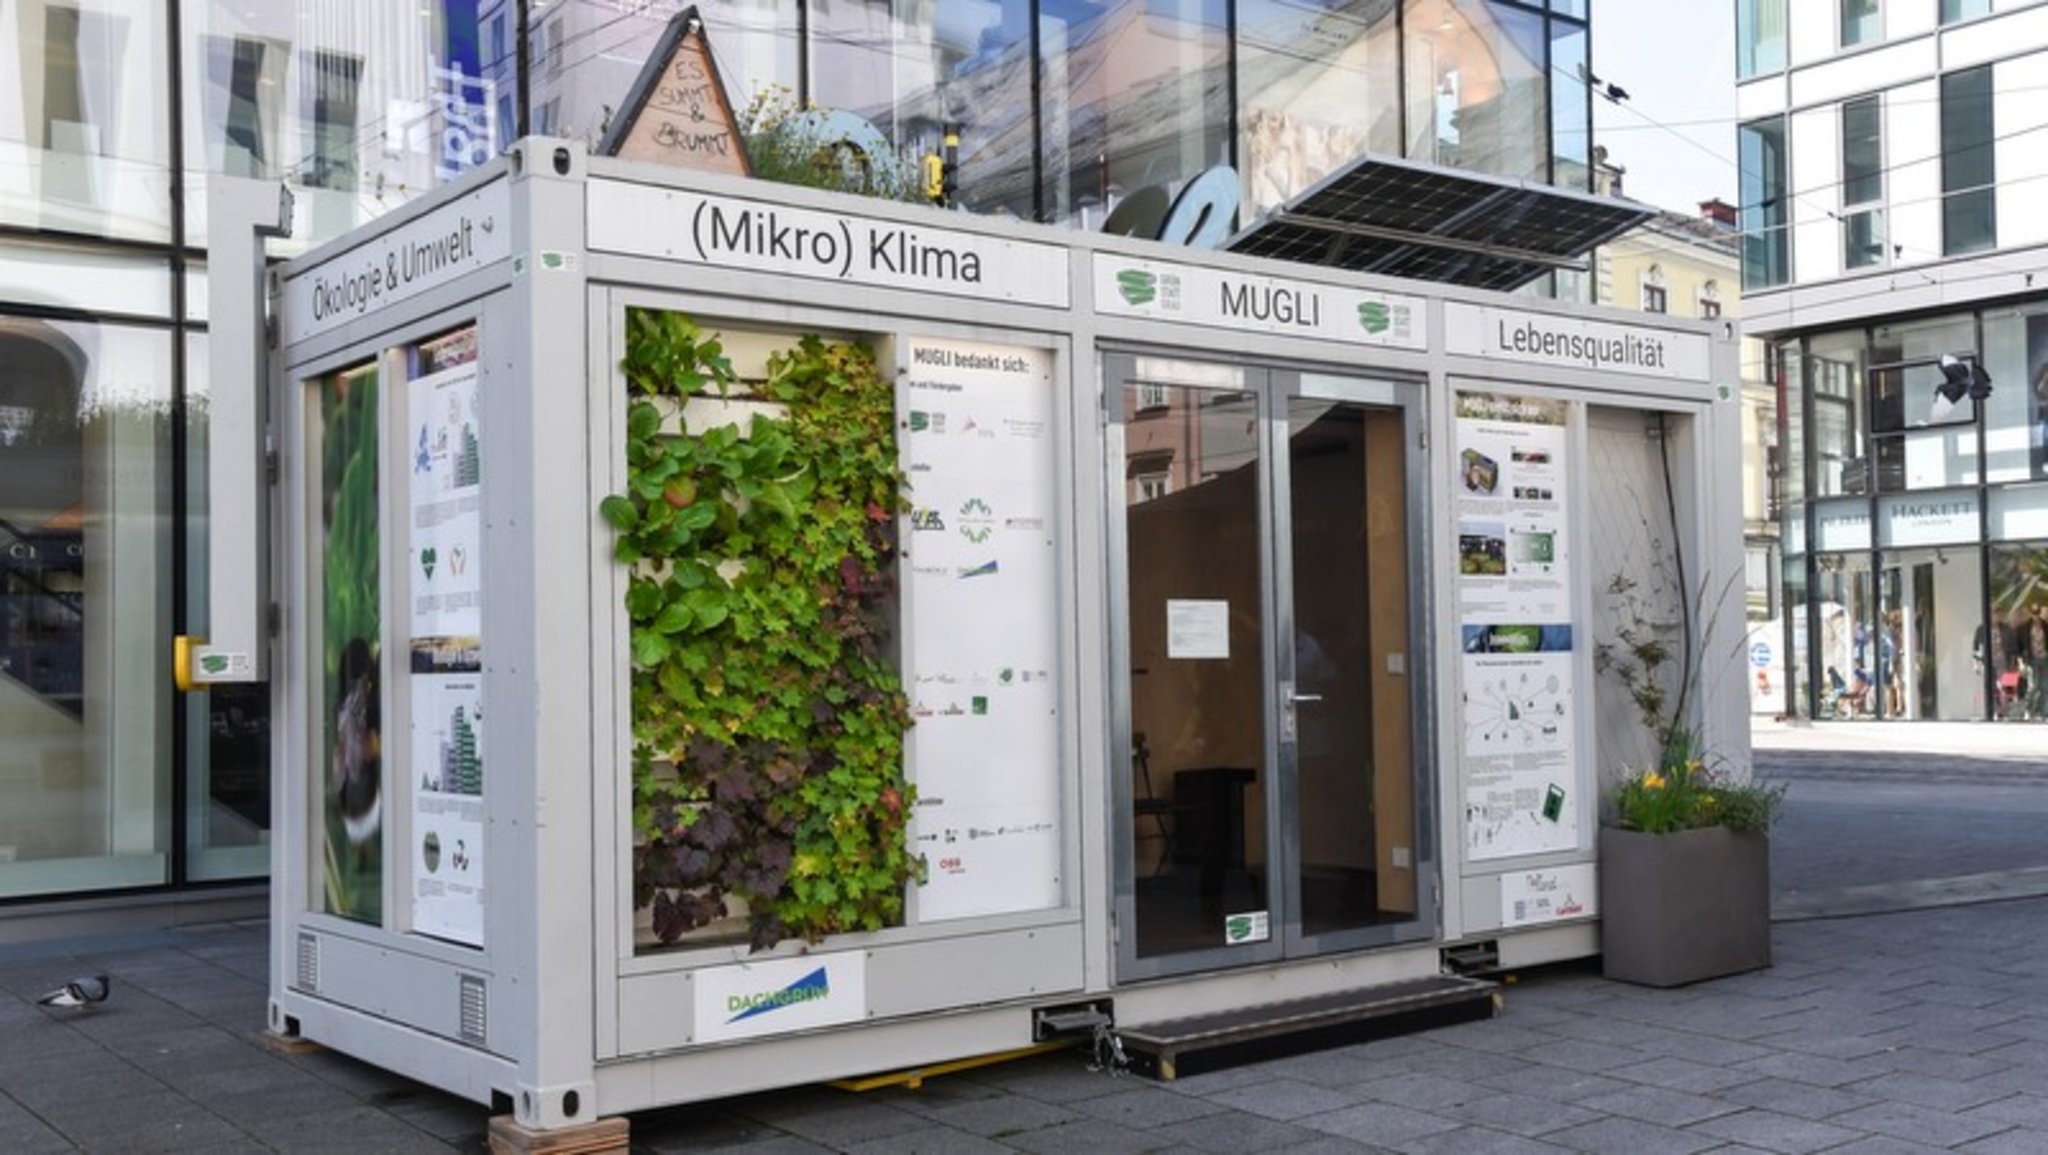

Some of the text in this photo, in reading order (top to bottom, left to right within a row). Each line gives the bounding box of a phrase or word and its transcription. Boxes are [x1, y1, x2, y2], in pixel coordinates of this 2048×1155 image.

[675, 61, 704, 80] ES
[660, 84, 712, 105] SUMMT
[690, 102, 705, 122] &
[652, 122, 728, 156] BRUMMT
[693, 199, 982, 283] (Mikro) Klima
[313, 216, 473, 321] Ökologie & Umwelt
[1220, 281, 1319, 327] MUGLI
[1499, 319, 1665, 368] Lebensqualität
[913, 347, 1030, 374] MUGLI bedankt sich:
[1890, 502, 1972, 519] HACKETT
